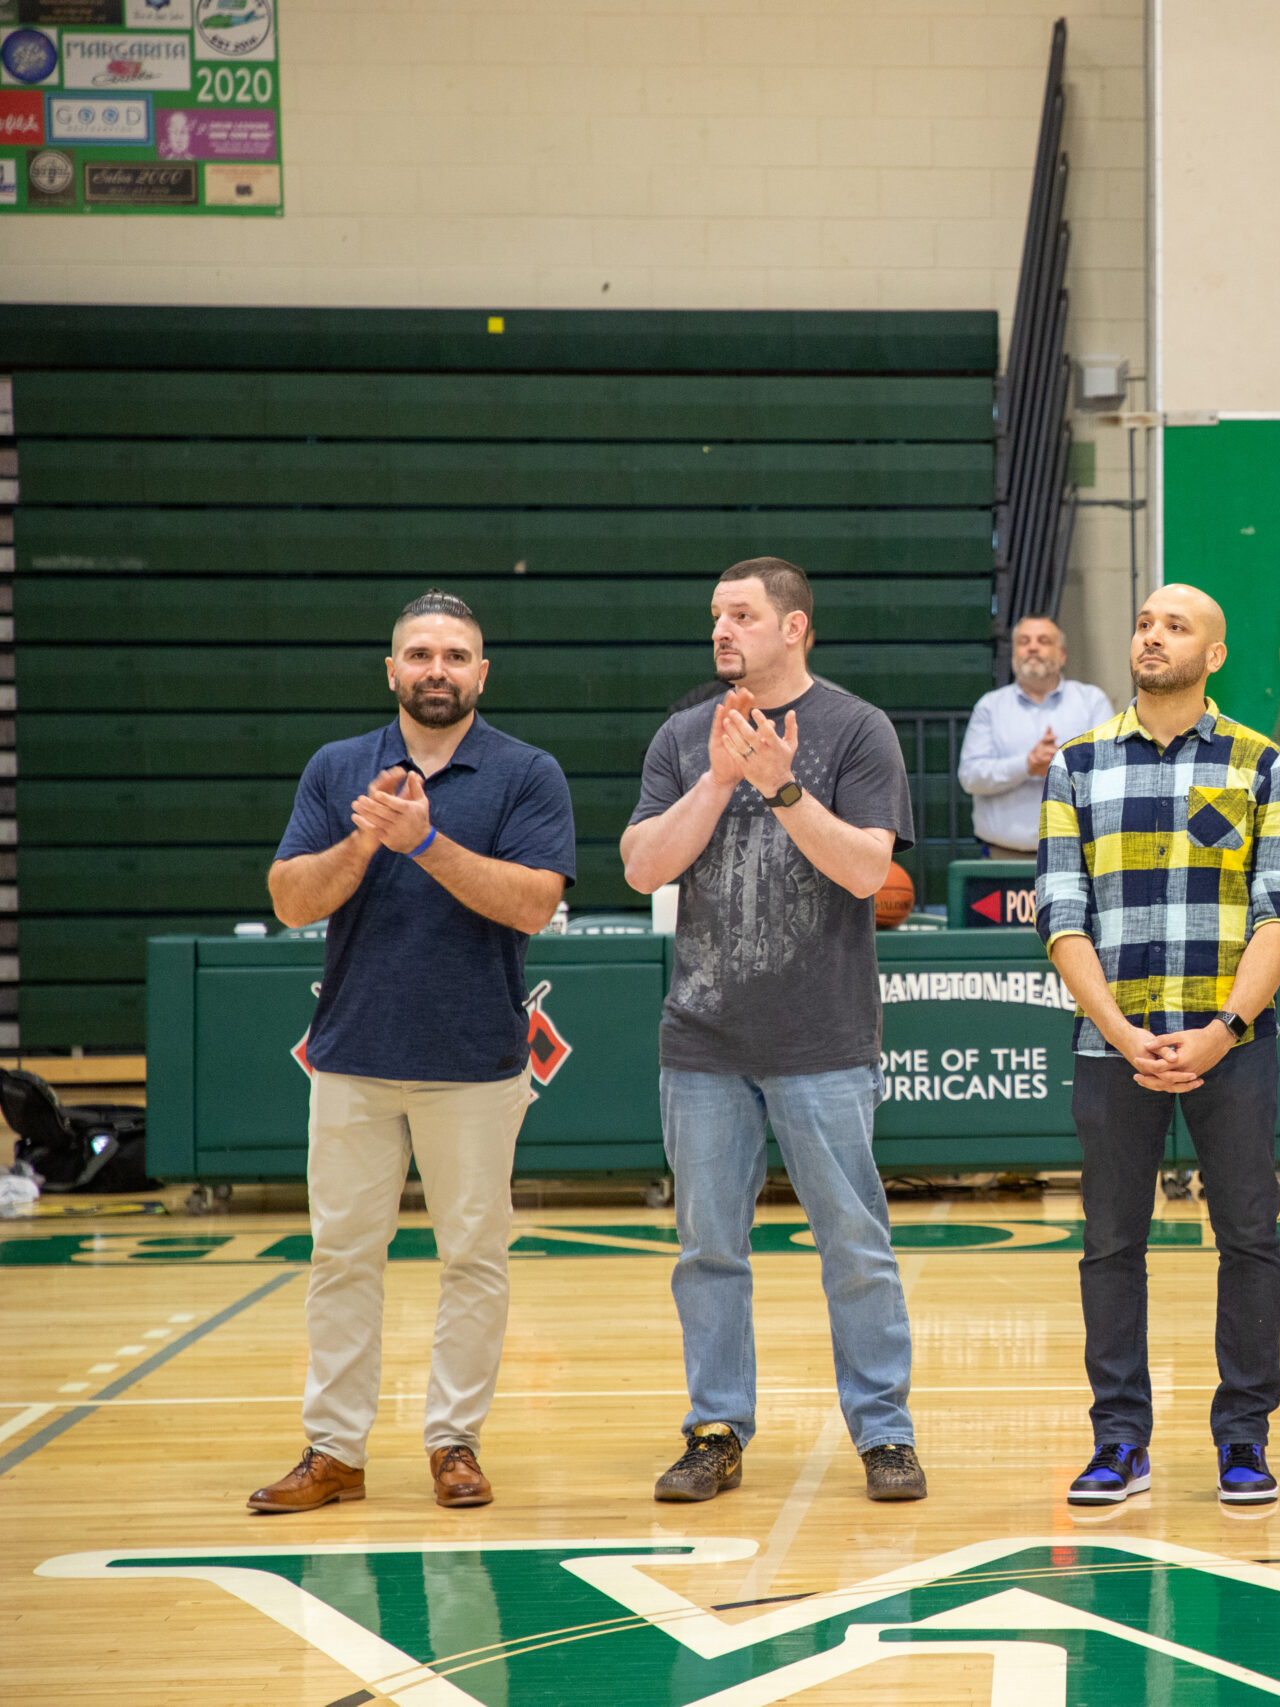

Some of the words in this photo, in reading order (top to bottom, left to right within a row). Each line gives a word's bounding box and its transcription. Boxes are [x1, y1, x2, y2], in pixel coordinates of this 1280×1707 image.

[66, 41, 186, 59] MARGARITA
[197, 67, 273, 103] 2020
[1007, 890, 1036, 923] POS
[941, 1048, 980, 1072] OF
[991, 1047, 1047, 1070] THE
